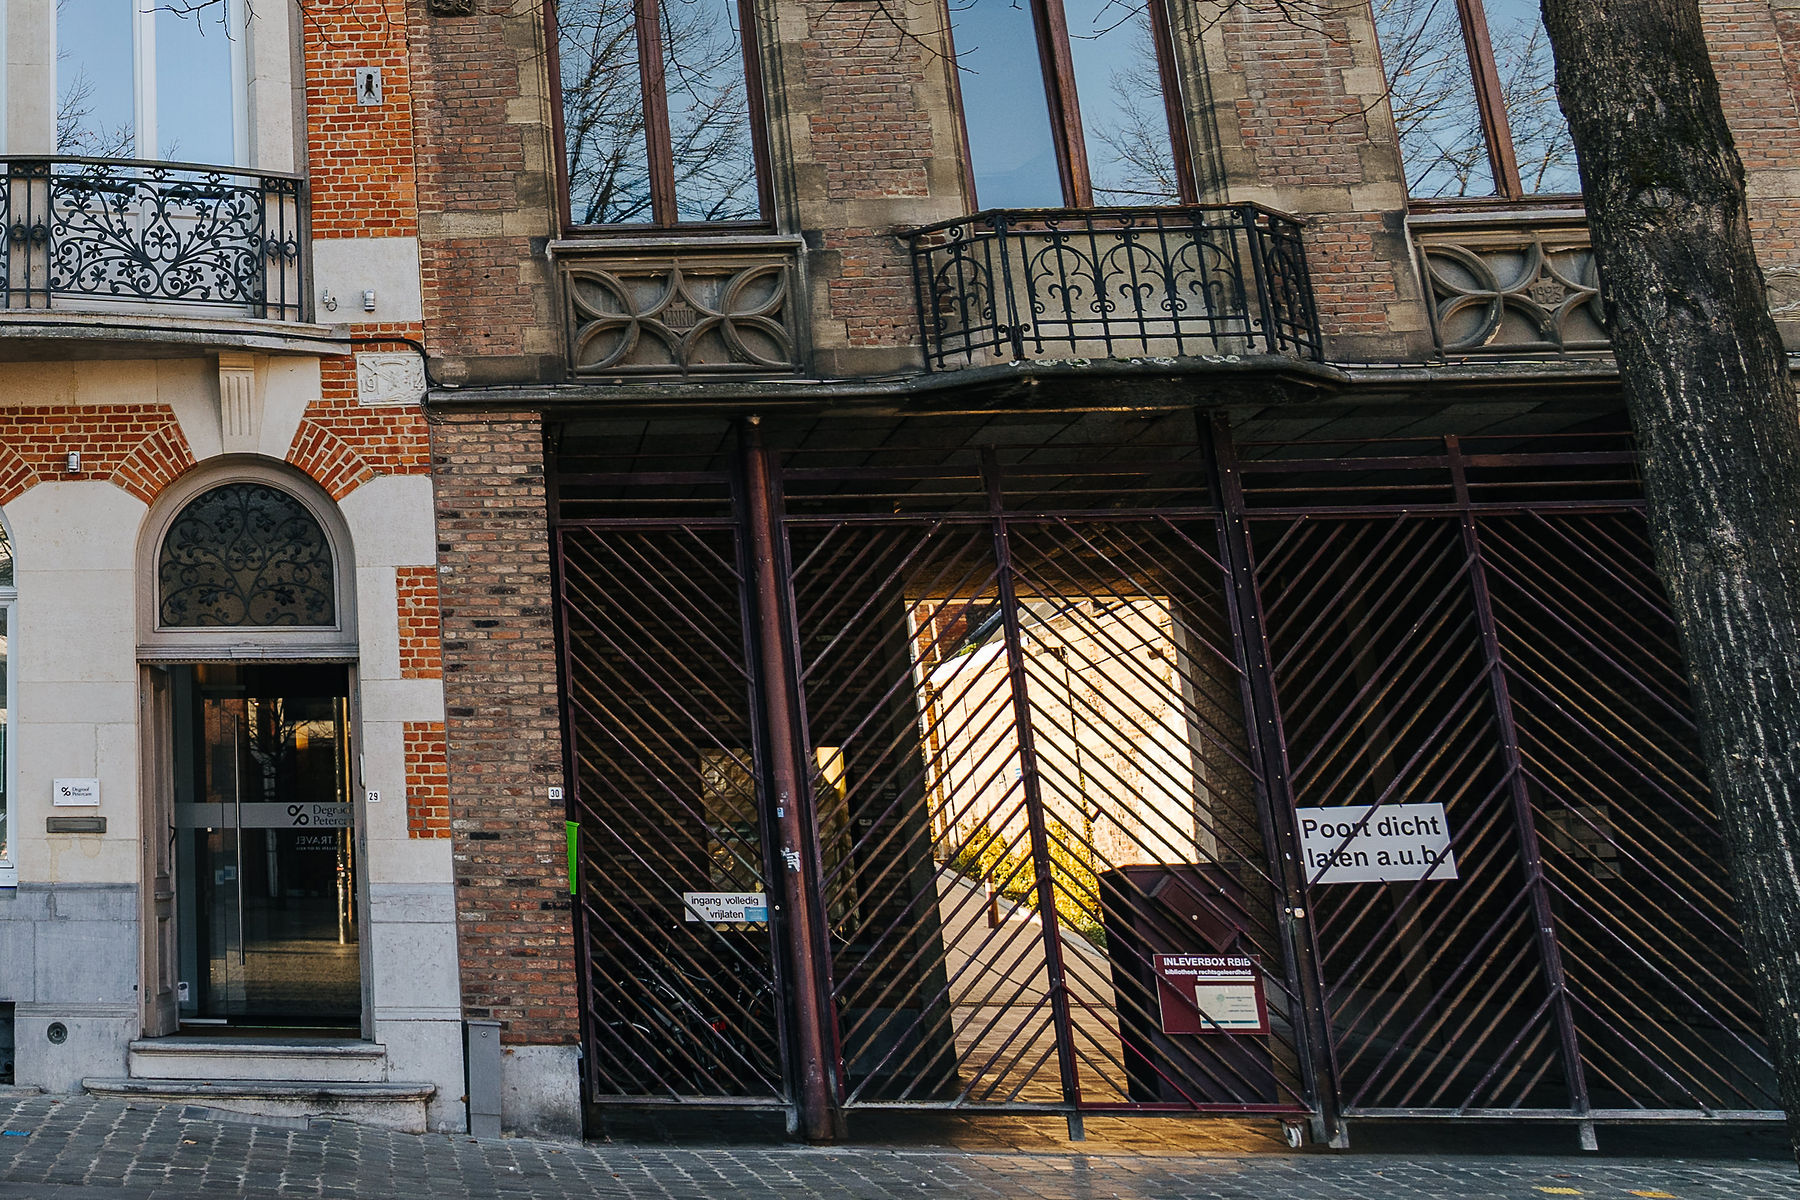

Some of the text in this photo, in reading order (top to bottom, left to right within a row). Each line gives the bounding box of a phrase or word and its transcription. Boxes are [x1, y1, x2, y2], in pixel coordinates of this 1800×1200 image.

[665, 308, 696, 327] ANNO
[368, 792, 379, 801] 29
[550, 788, 560, 798] 30
[1301, 815, 1441, 839] Poort dicht
[1307, 844, 1446, 868] laten a.u.b.
[691, 896, 759, 906] ingang volledig
[709, 909, 744, 920] vrijlaten
[1163, 957, 1226, 966] INLEVERBOX
[1198, 968, 1252, 976] rechtsgeleerdheid
